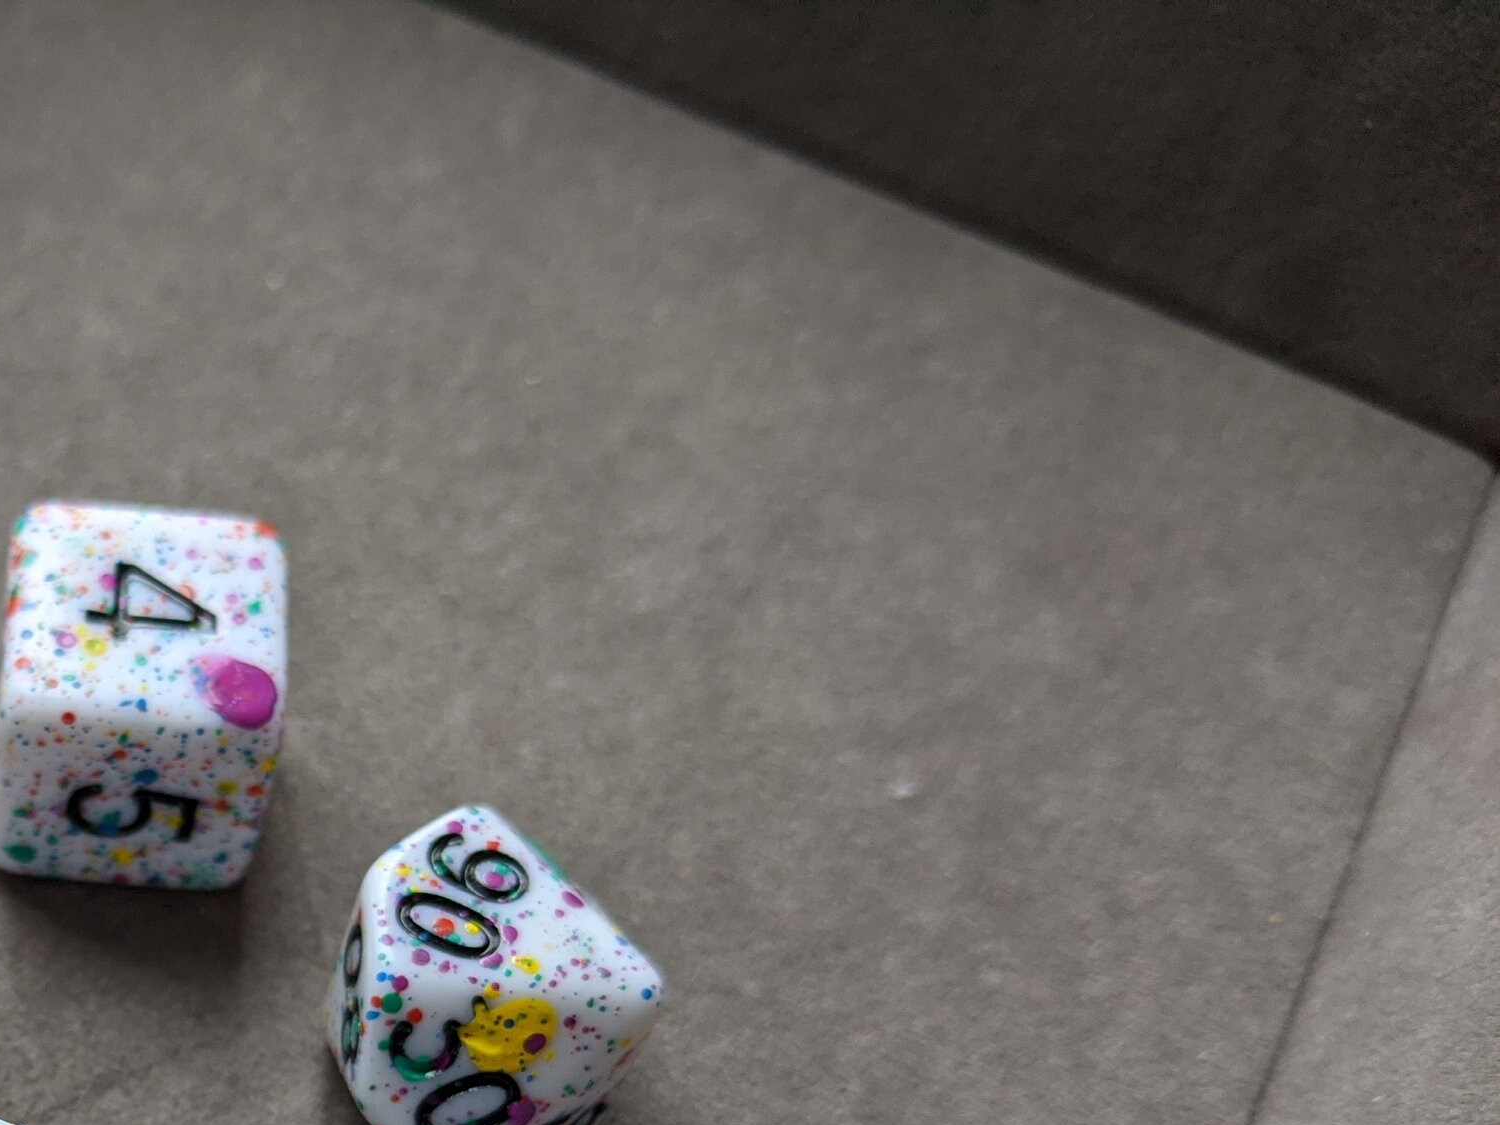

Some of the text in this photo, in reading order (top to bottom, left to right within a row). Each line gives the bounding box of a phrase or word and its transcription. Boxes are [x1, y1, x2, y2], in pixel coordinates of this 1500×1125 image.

[86, 562, 217, 639] 4
[66, 783, 201, 842] 5
[396, 832, 530, 960] 90
